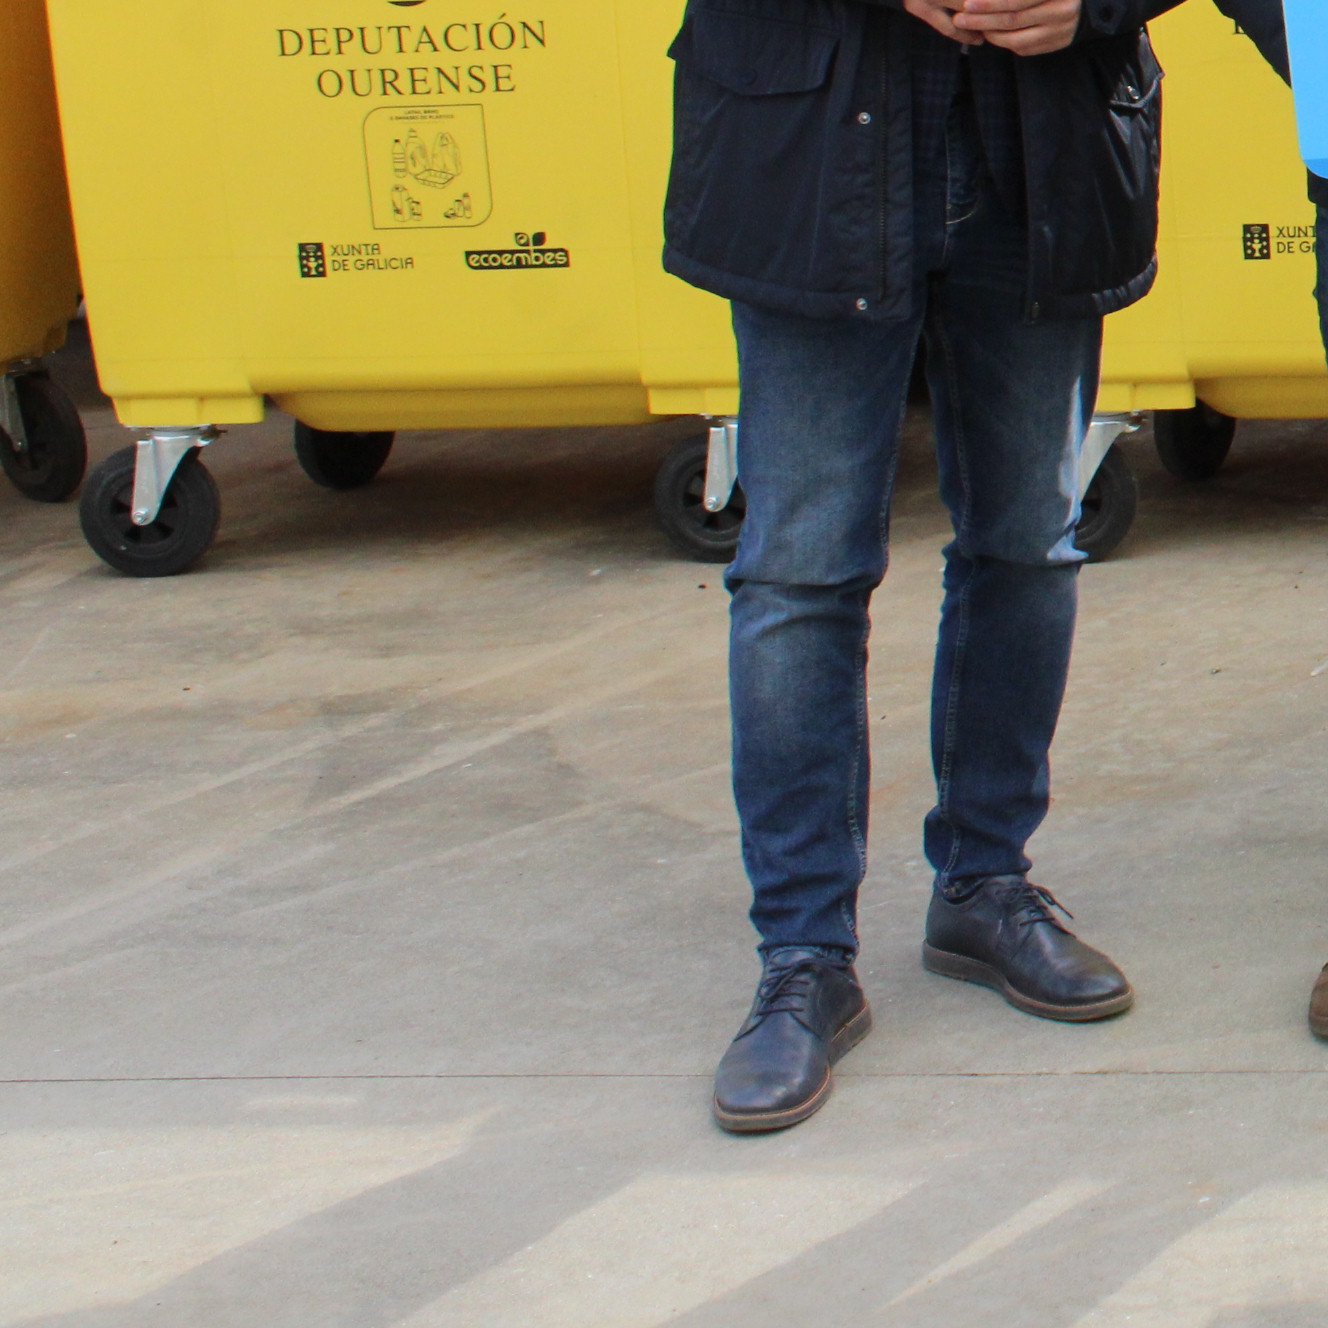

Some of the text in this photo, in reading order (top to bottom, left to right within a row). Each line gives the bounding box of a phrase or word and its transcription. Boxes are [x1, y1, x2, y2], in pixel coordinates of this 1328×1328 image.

[276, 12, 547, 57] DEPUTACIÓN
[316, 63, 517, 99] OURENSE
[1276, 225, 1316, 239] XUNT
[330, 243, 382, 257] XUNTA
[1276, 241, 1296, 254] DE
[331, 256, 415, 272] DE GALICIA
[467, 247, 569, 268] ecoembes
